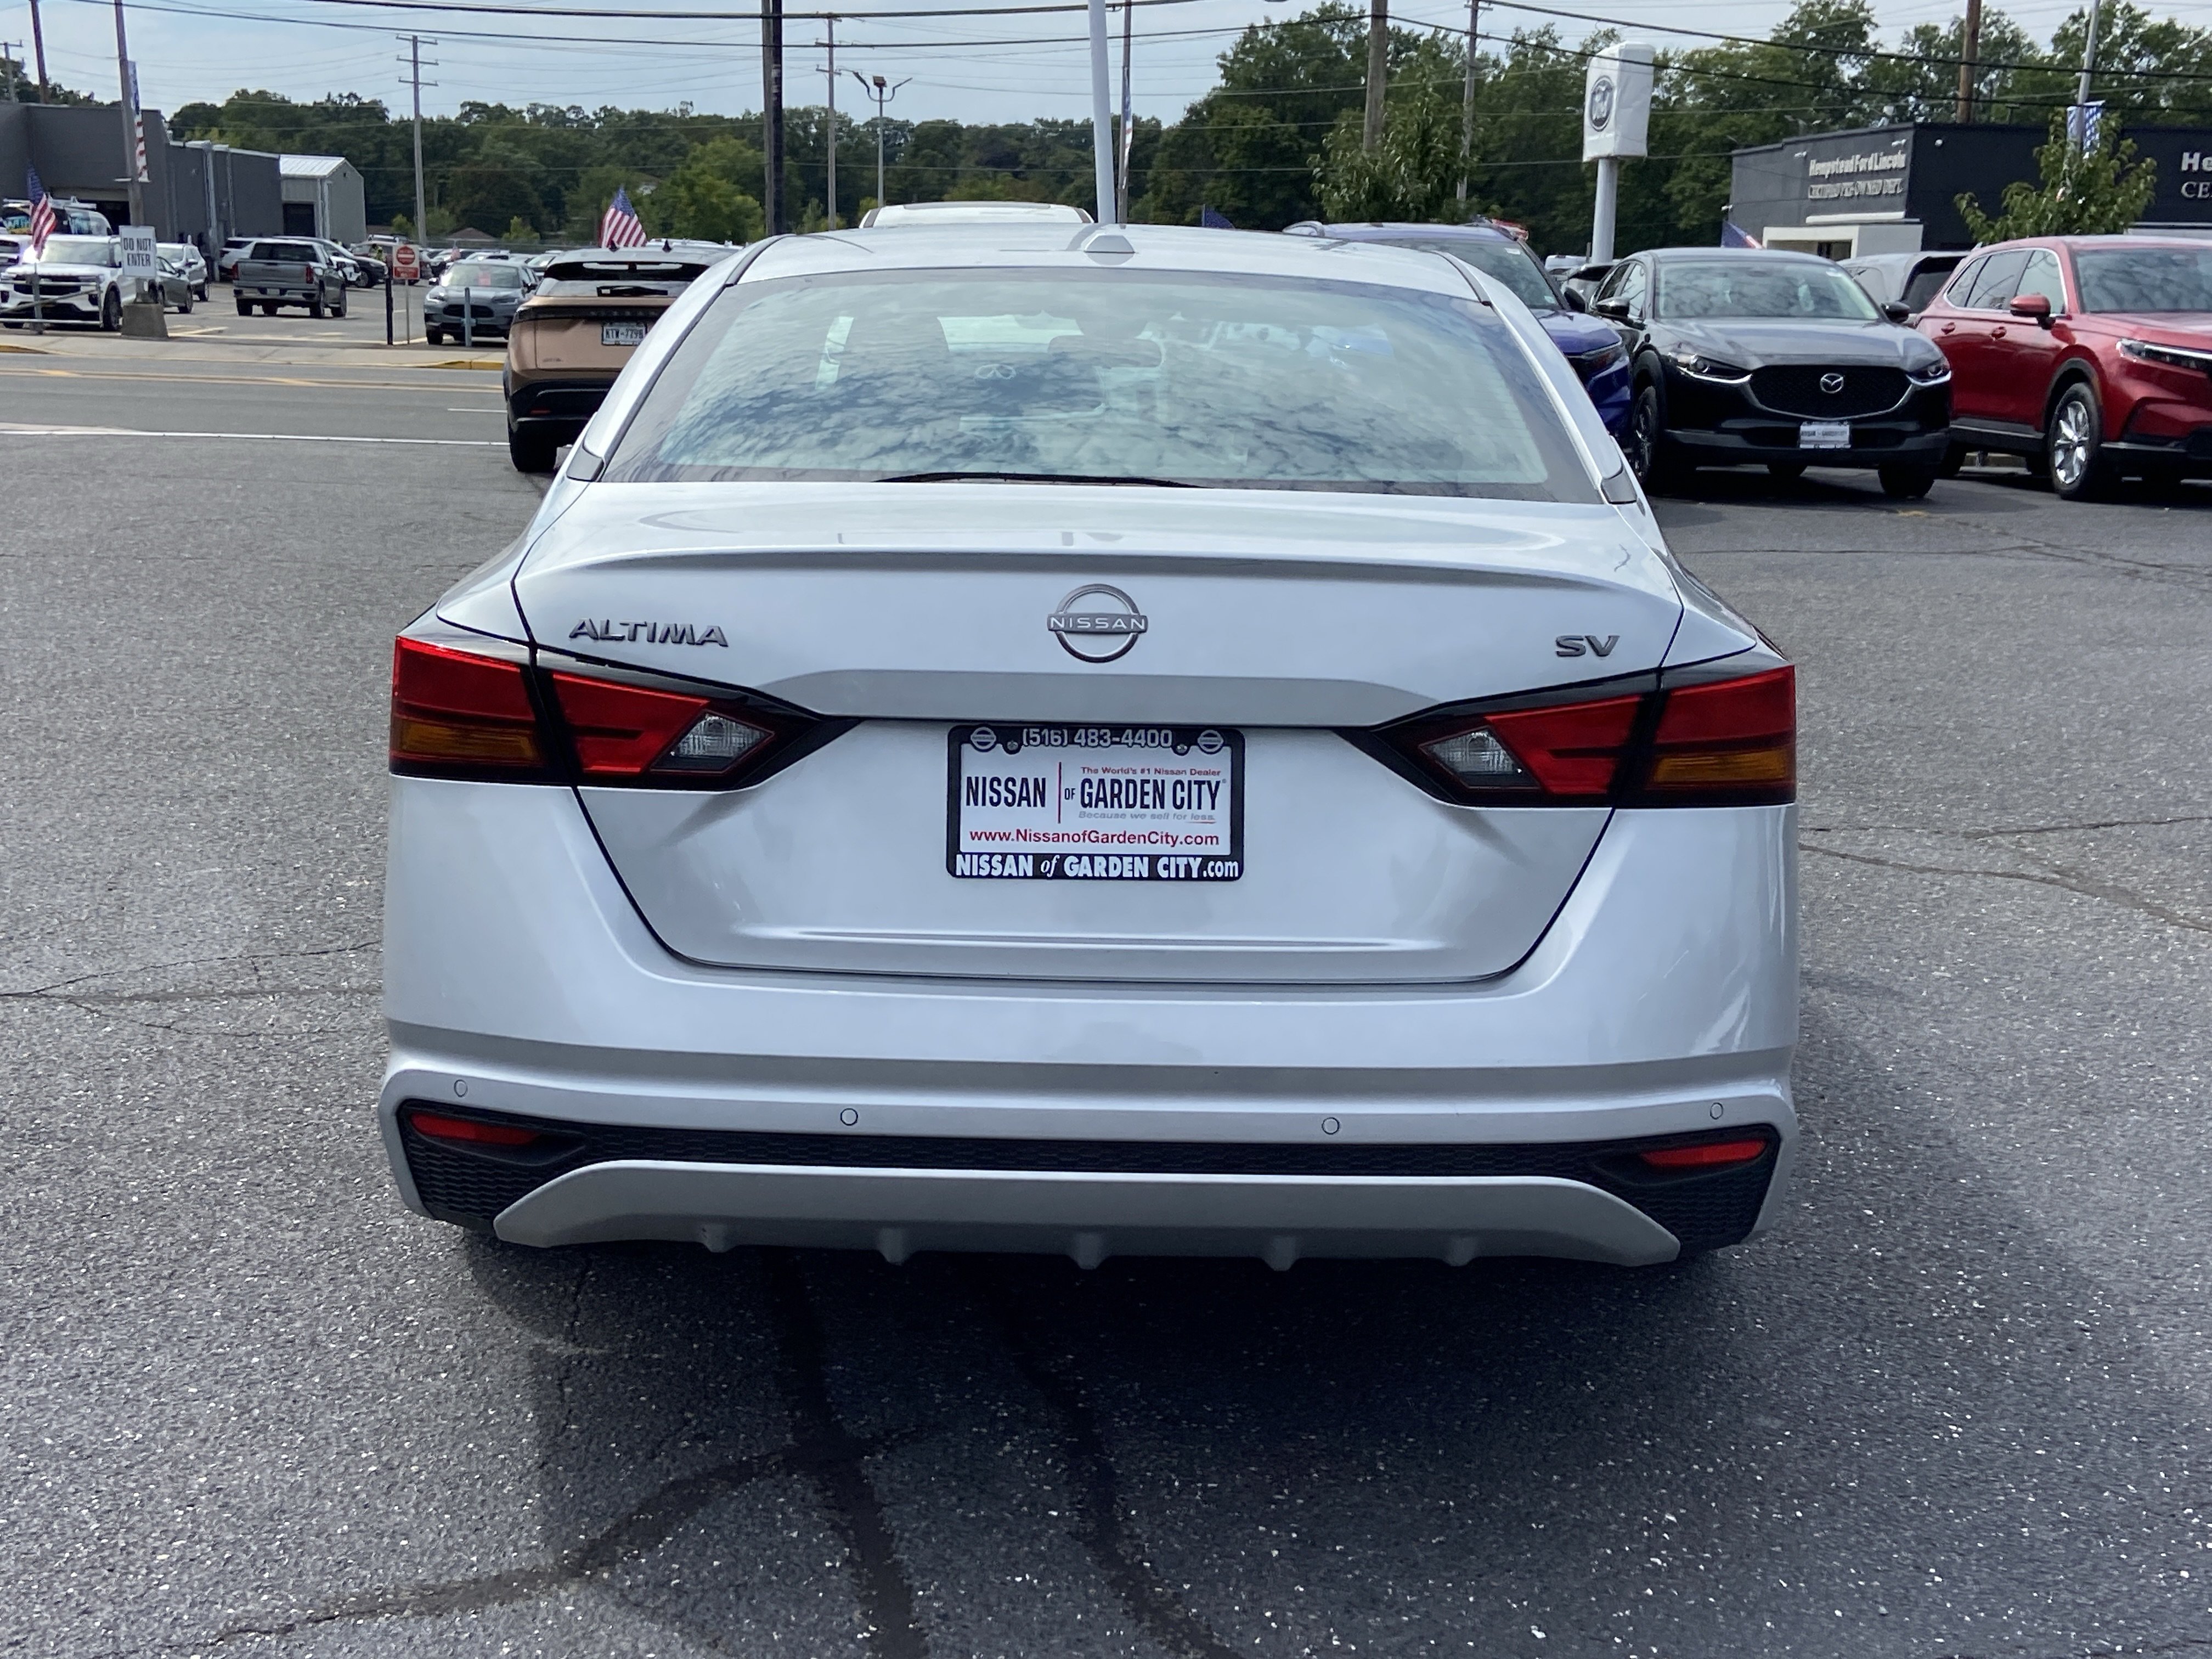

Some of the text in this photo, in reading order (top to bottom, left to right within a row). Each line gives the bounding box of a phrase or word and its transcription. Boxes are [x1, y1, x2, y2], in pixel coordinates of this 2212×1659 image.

[2181, 181, 2212, 198] CE
[123, 238, 151, 251] DO NOT
[127, 253, 151, 267] ENTER
[569, 618, 729, 647] ALTIMA
[1050, 617, 1146, 630] NISSAN
[1555, 635, 1620, 657] SV
[1023, 729, 1172, 748] (516) 483-4400
[966, 777, 1221, 810] NISSAN OF GARDEN CITY
[1079, 811, 1126, 819] Because
[970, 828, 1219, 847] www.NissanofGardenCity.com
[956, 854, 1239, 878] NISSAN of GARDEN CITY.com
